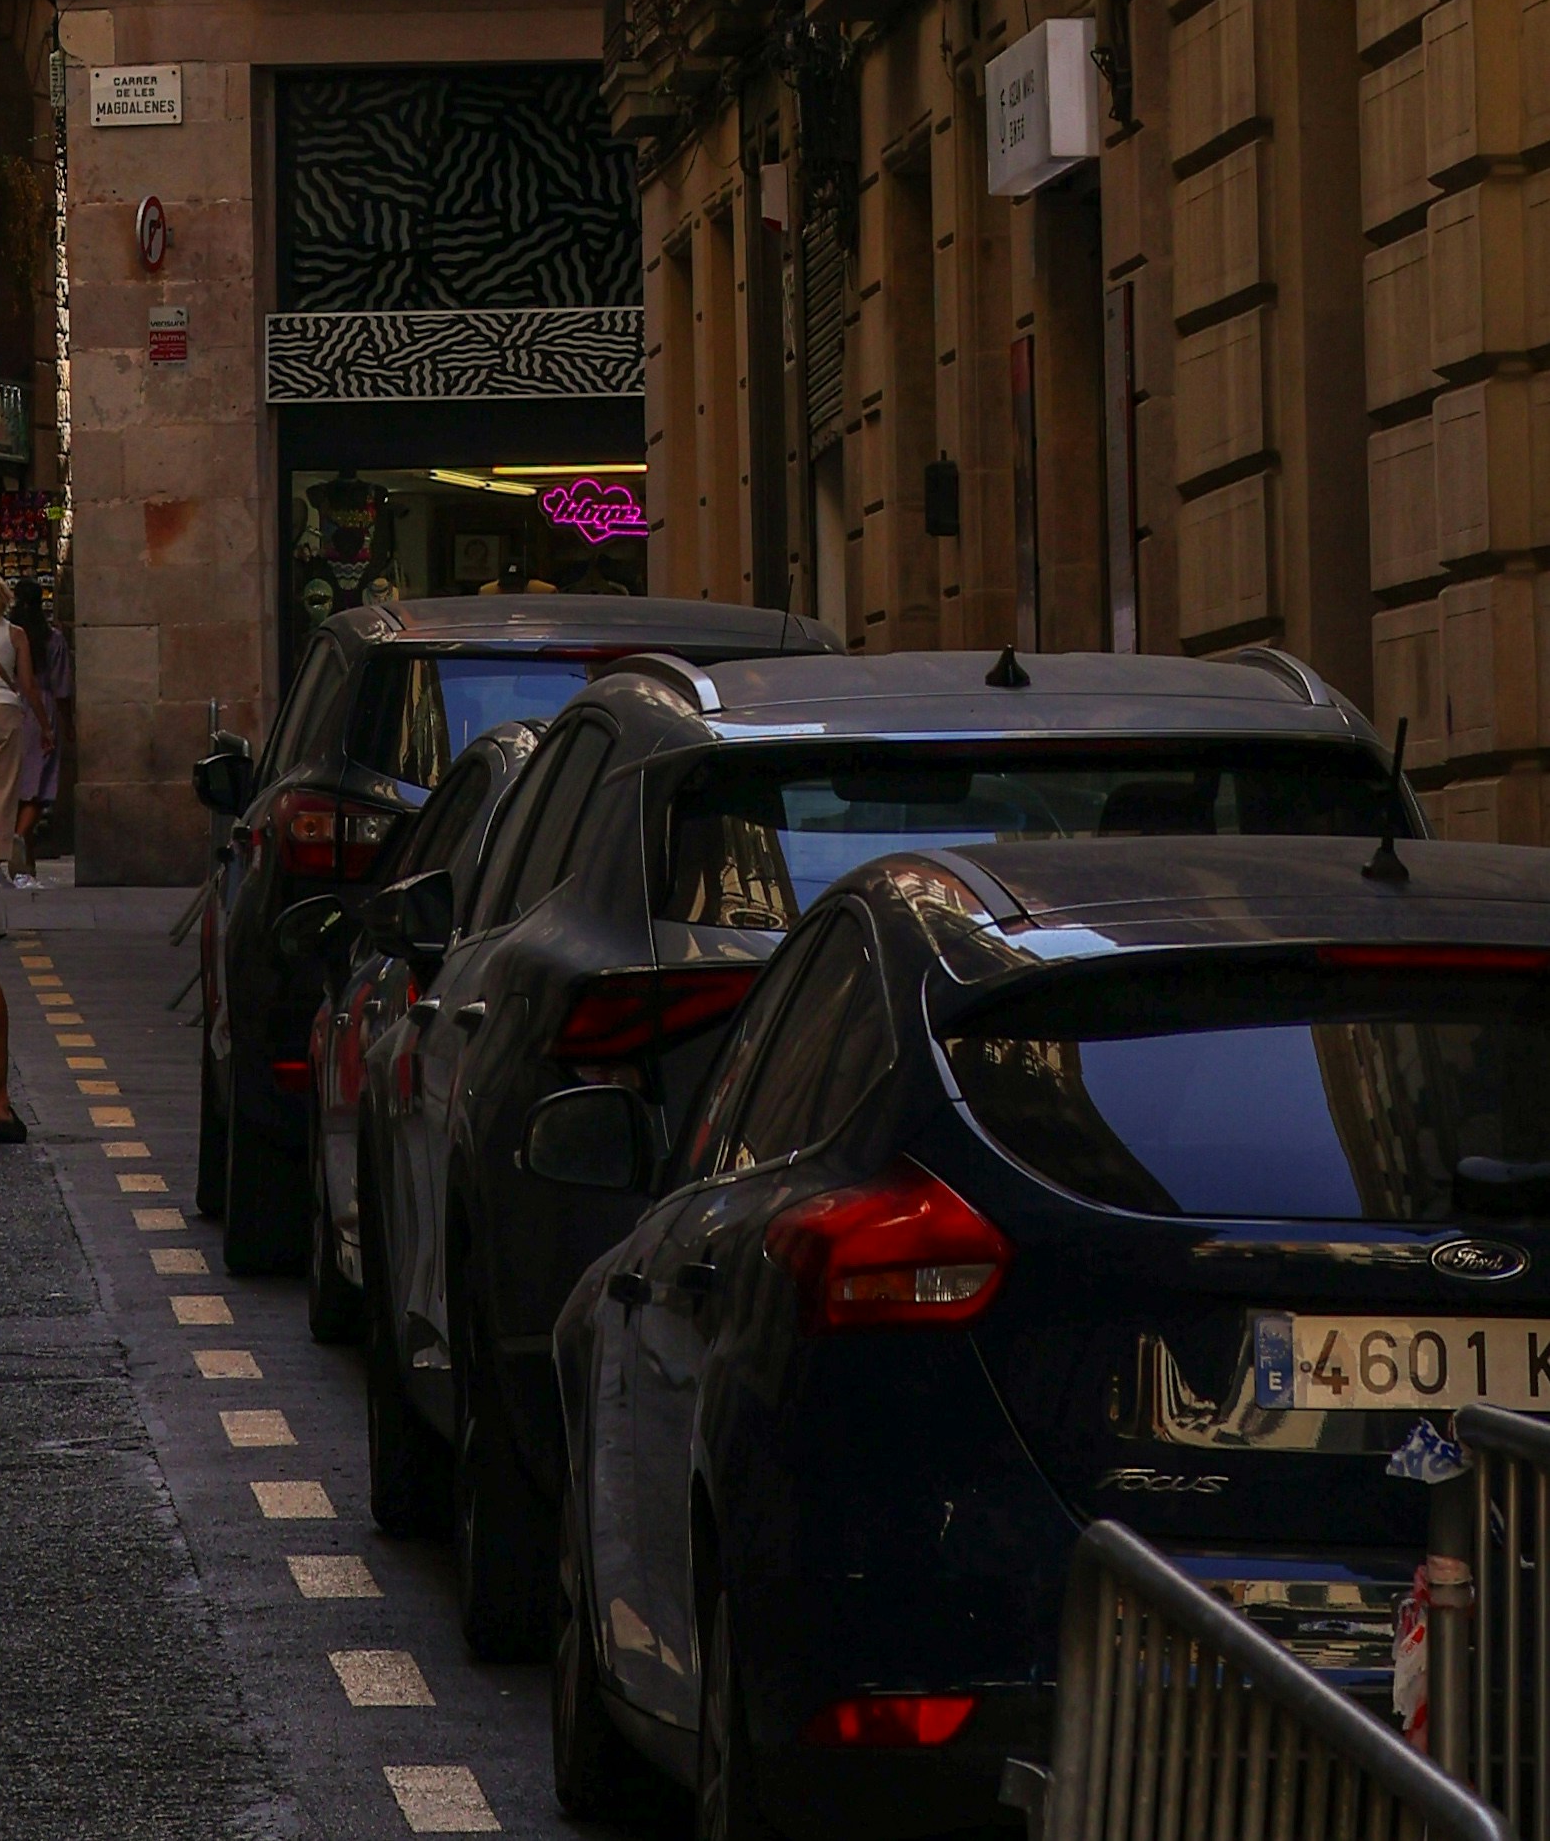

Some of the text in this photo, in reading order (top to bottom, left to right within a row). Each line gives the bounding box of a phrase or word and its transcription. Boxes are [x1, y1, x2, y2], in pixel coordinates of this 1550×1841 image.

[113, 77, 158, 86] CARRER
[116, 88, 155, 98] DE LES
[96, 100, 175, 115] MAGDALENES
[1453, 1247, 1505, 1270] Ford
[1311, 1329, 1488, 1397] 4601
